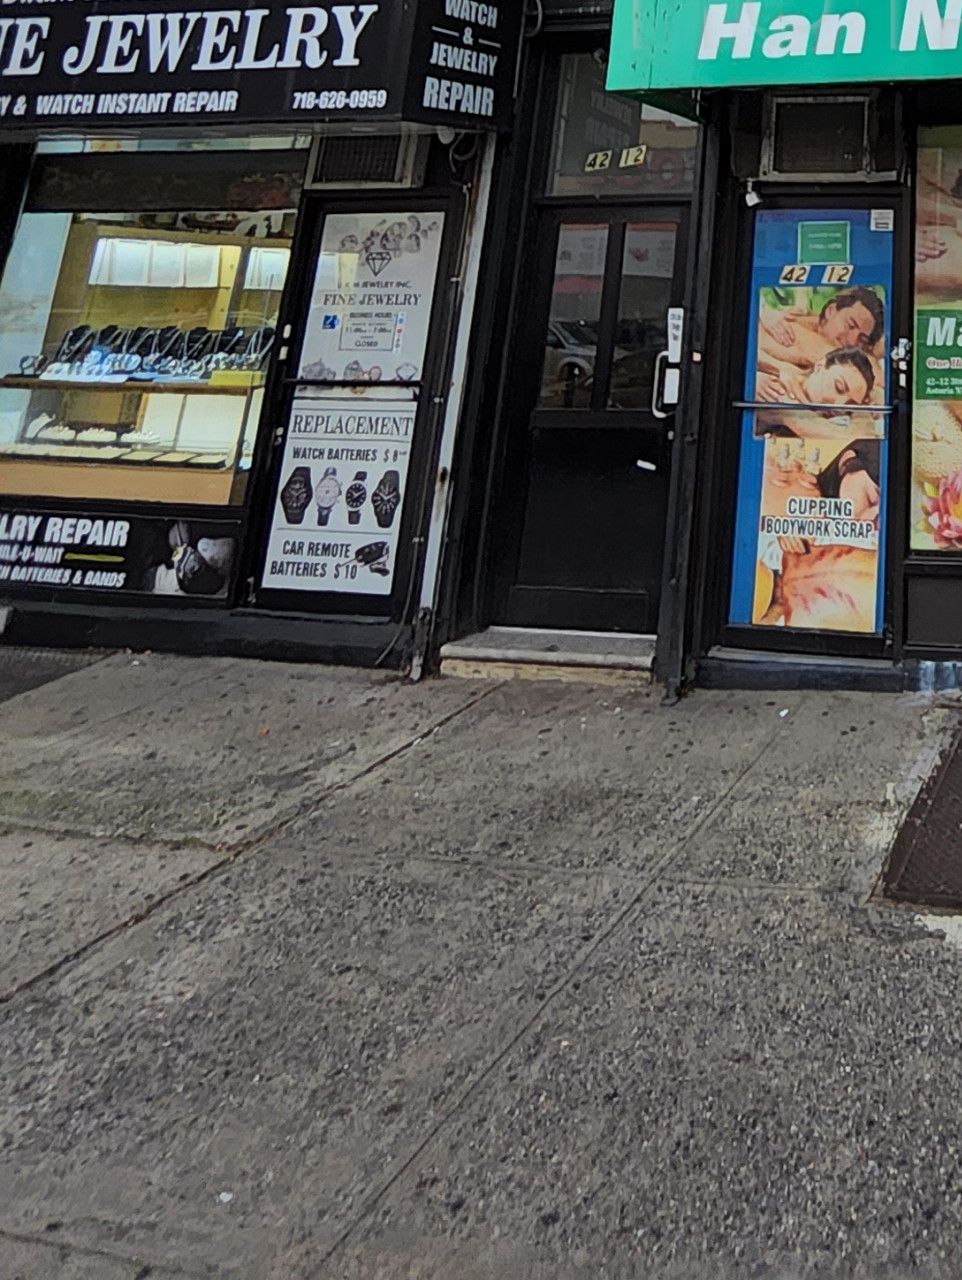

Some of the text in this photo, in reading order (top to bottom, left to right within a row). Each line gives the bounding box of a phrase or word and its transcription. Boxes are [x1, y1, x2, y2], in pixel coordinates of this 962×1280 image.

[62, 4, 380, 76] JEWELRY
[462, 26, 474, 46] &
[697, 1, 867, 60] Han
[429, 41, 498, 77] JEWELRY
[12, 94, 28, 117] &
[36, 94, 96, 116] WATCH
[97, 91, 172, 115] INSTANT
[172, 90, 239, 114] REPAIR
[422, 75, 495, 117] REPAIR
[586, 147, 643, 169] 42 12
[782, 266, 851, 283] 42 12
[323, 293, 421, 306] FINE JEWELRY
[291, 413, 413, 437] REPLACEMENT
[292, 446, 325, 460] WATCH
[327, 448, 377, 462] BATTERIES
[788, 498, 852, 517] CUPPING
[44, 517, 130, 547] REPAIR
[766, 518, 873, 538] BODYWORK SCRAP
[283, 540, 351, 558] CAR REMOTE
[10, 566, 72, 584] BATTERIES
[72, 569, 83, 584] &
[84, 570, 127, 588] BANDS
[270, 561, 327, 577] BATTERIES
